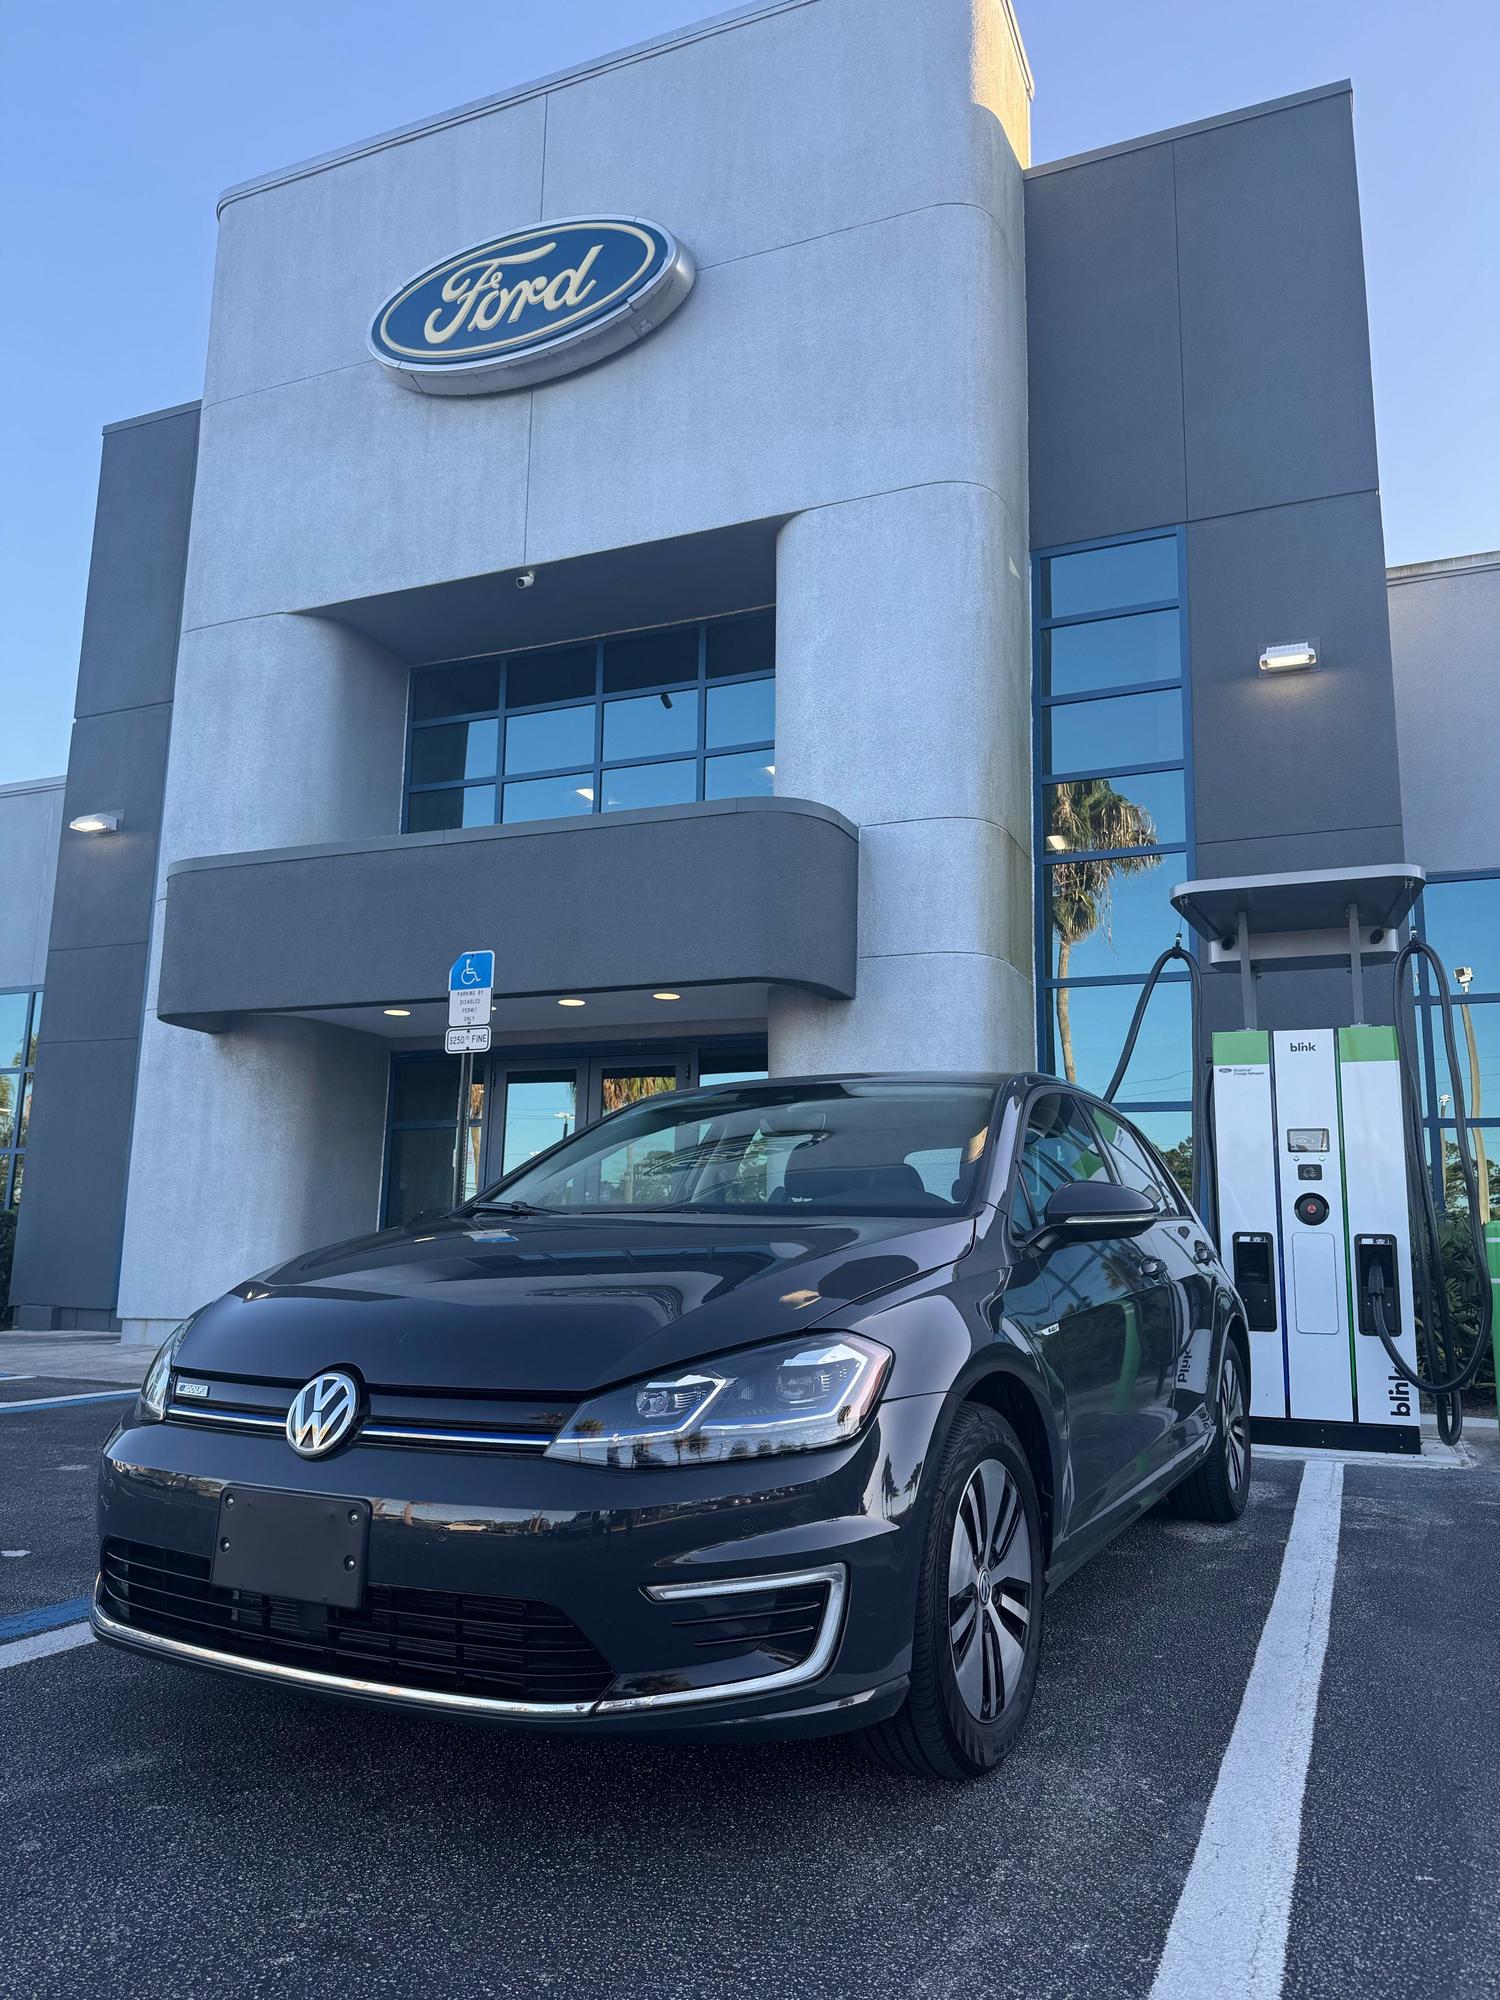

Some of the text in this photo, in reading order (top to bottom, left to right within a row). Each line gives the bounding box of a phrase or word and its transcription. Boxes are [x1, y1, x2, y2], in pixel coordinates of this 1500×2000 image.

[424, 242, 604, 344] Ford
[472, 1034, 487, 1043] FINE
[1290, 1042, 1316, 1052] blink
